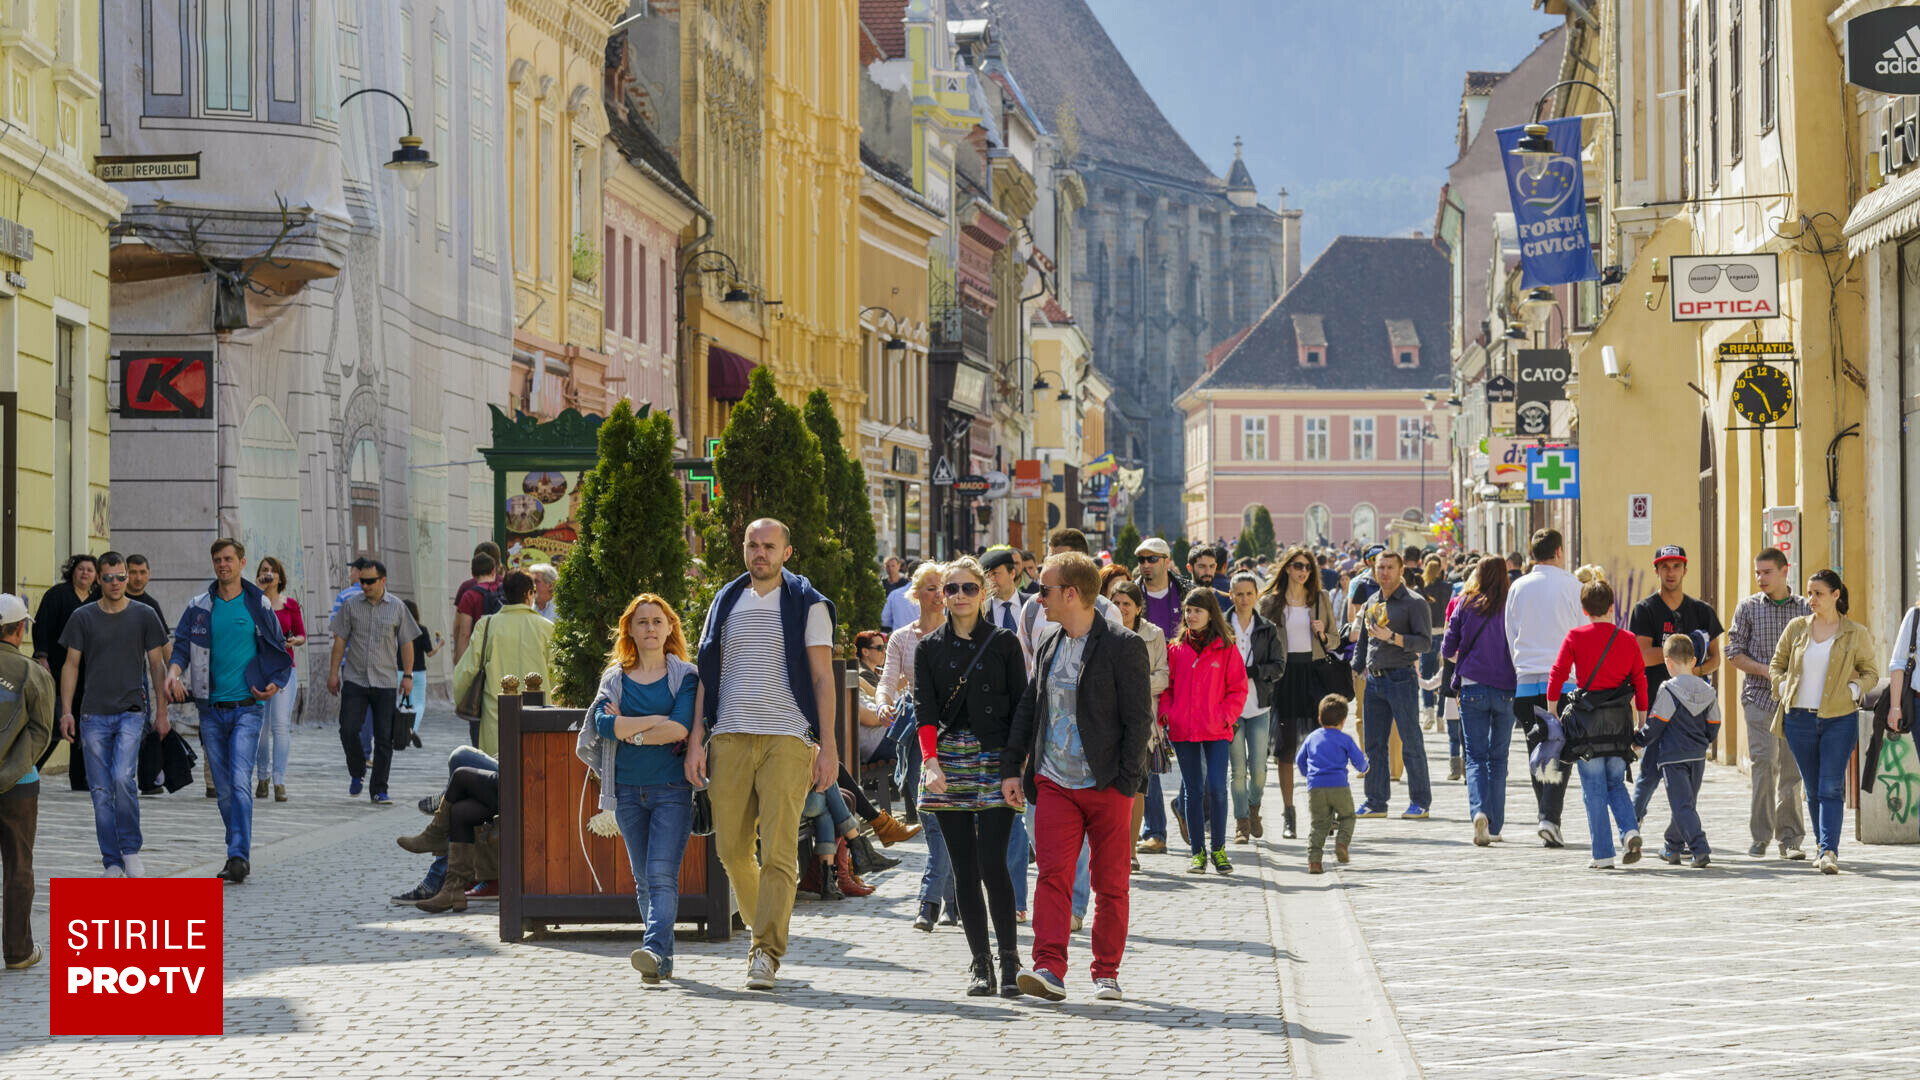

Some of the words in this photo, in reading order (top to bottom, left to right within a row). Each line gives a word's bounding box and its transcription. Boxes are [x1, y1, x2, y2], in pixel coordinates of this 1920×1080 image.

[136, 163, 189, 176] REPUBLICII
[1679, 299, 1771, 315] OPTICA
[1729, 343, 1786, 353] REPARATII
[1521, 367, 1566, 382] CATO
[1744, 369, 1754, 379] 11
[1757, 367, 1767, 376] 12
[1774, 369, 1779, 378] 1
[1736, 379, 1746, 389] 10
[1782, 377, 1788, 387] 2
[1733, 391, 1740, 400] 9
[1786, 389, 1792, 399] 3
[1738, 402, 1744, 412] 8
[1782, 402, 1788, 411] 4
[1747, 412, 1754, 421] 7
[1759, 413, 1765, 422] 6
[1772, 411, 1779, 420] 5
[959, 481, 985, 490] MADO
